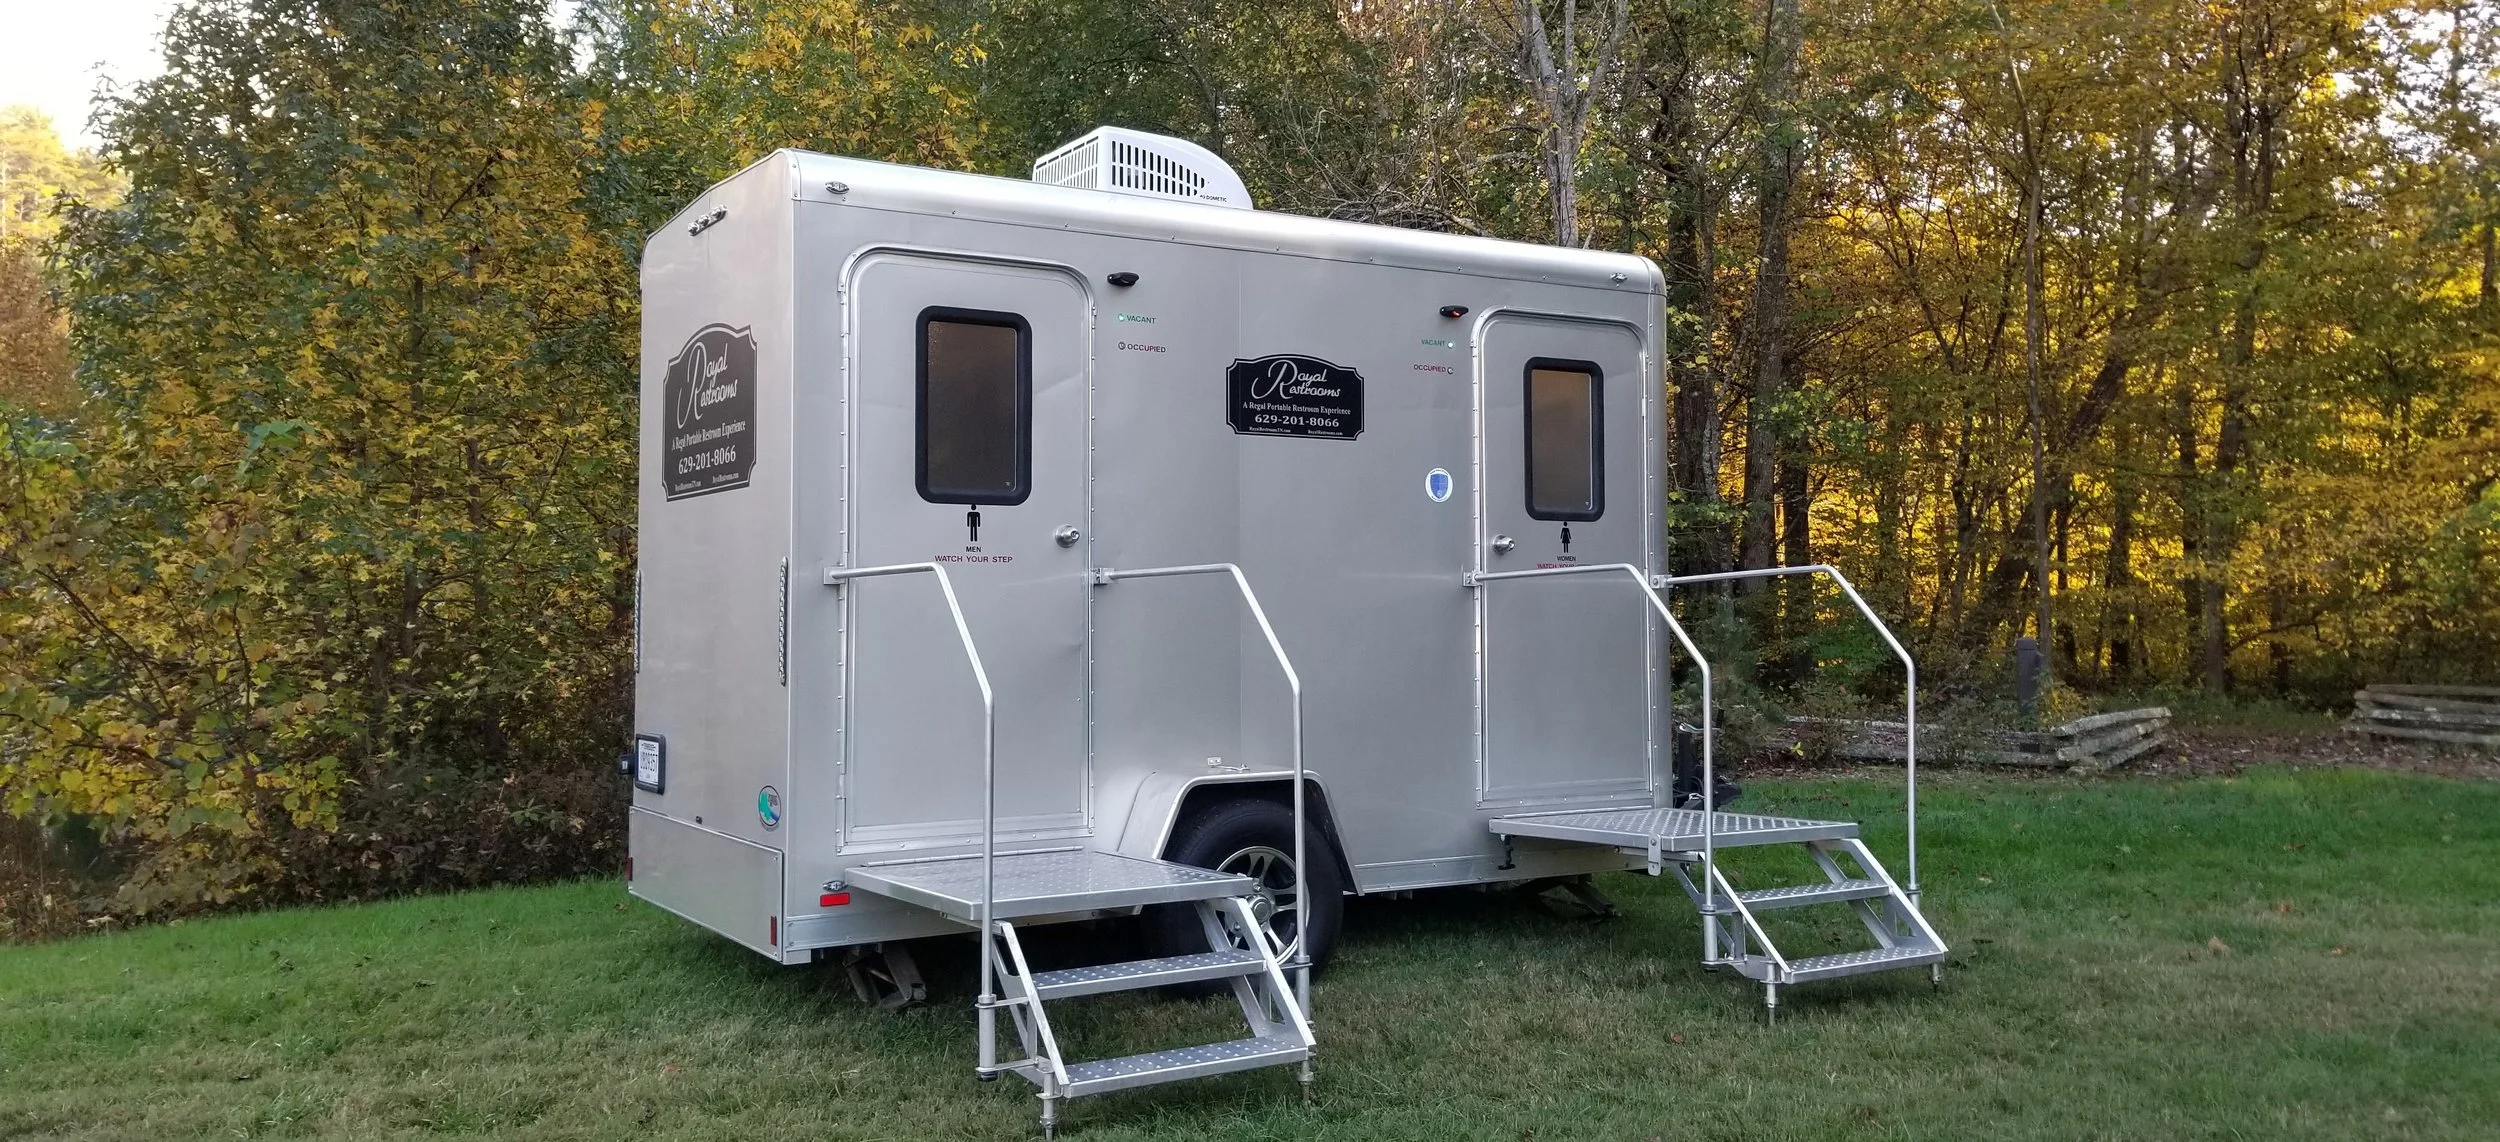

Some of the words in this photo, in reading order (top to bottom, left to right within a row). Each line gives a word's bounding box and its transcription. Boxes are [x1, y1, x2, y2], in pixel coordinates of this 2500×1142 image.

[1126, 315, 1156, 324] VACANT
[1127, 343, 1166, 353] OCCUPIED
[1421, 339, 1445, 347] VACANT
[1414, 364, 1446, 372] OCCUPIED
[676, 342, 728, 429] Royal
[1251, 360, 1327, 399] Royal
[1249, 402, 1266, 411] Regal
[1267, 403, 1292, 412] Portable
[1292, 404, 1319, 413] Restroom
[1320, 406, 1351, 416] Experience
[1254, 414, 1339, 428] 629-201-8066
[722, 420, 746, 438] Experience
[678, 445, 736, 475] 629-201-8066
